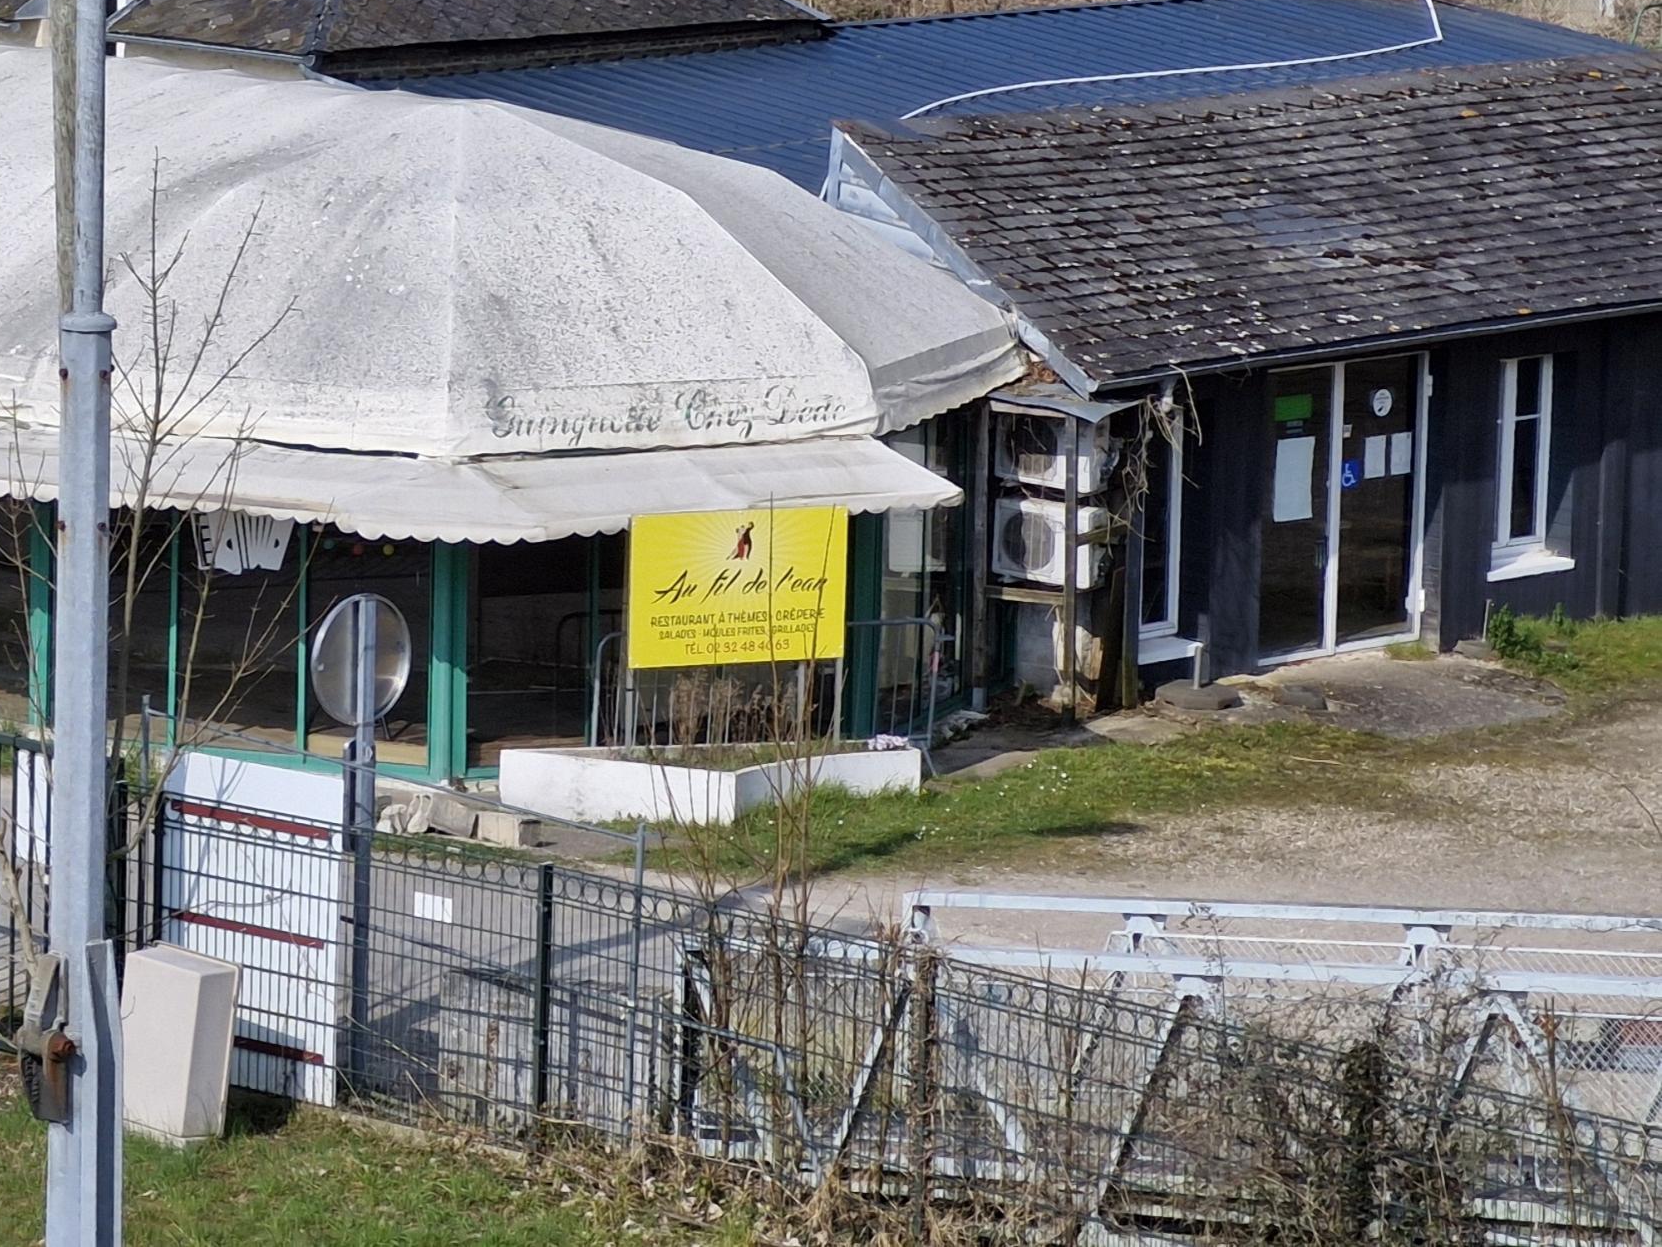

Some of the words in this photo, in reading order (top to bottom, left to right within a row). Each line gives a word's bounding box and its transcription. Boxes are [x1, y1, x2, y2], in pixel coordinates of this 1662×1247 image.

[651, 569, 698, 605] Au
[700, 568, 742, 605] fil
[742, 568, 768, 594] de
[775, 566, 828, 593] l'eau
[650, 613, 715, 628] RESTAURANT
[775, 607, 826, 622] CRÊPERE
[740, 640, 755, 652] 48
[775, 639, 790, 651] 63
